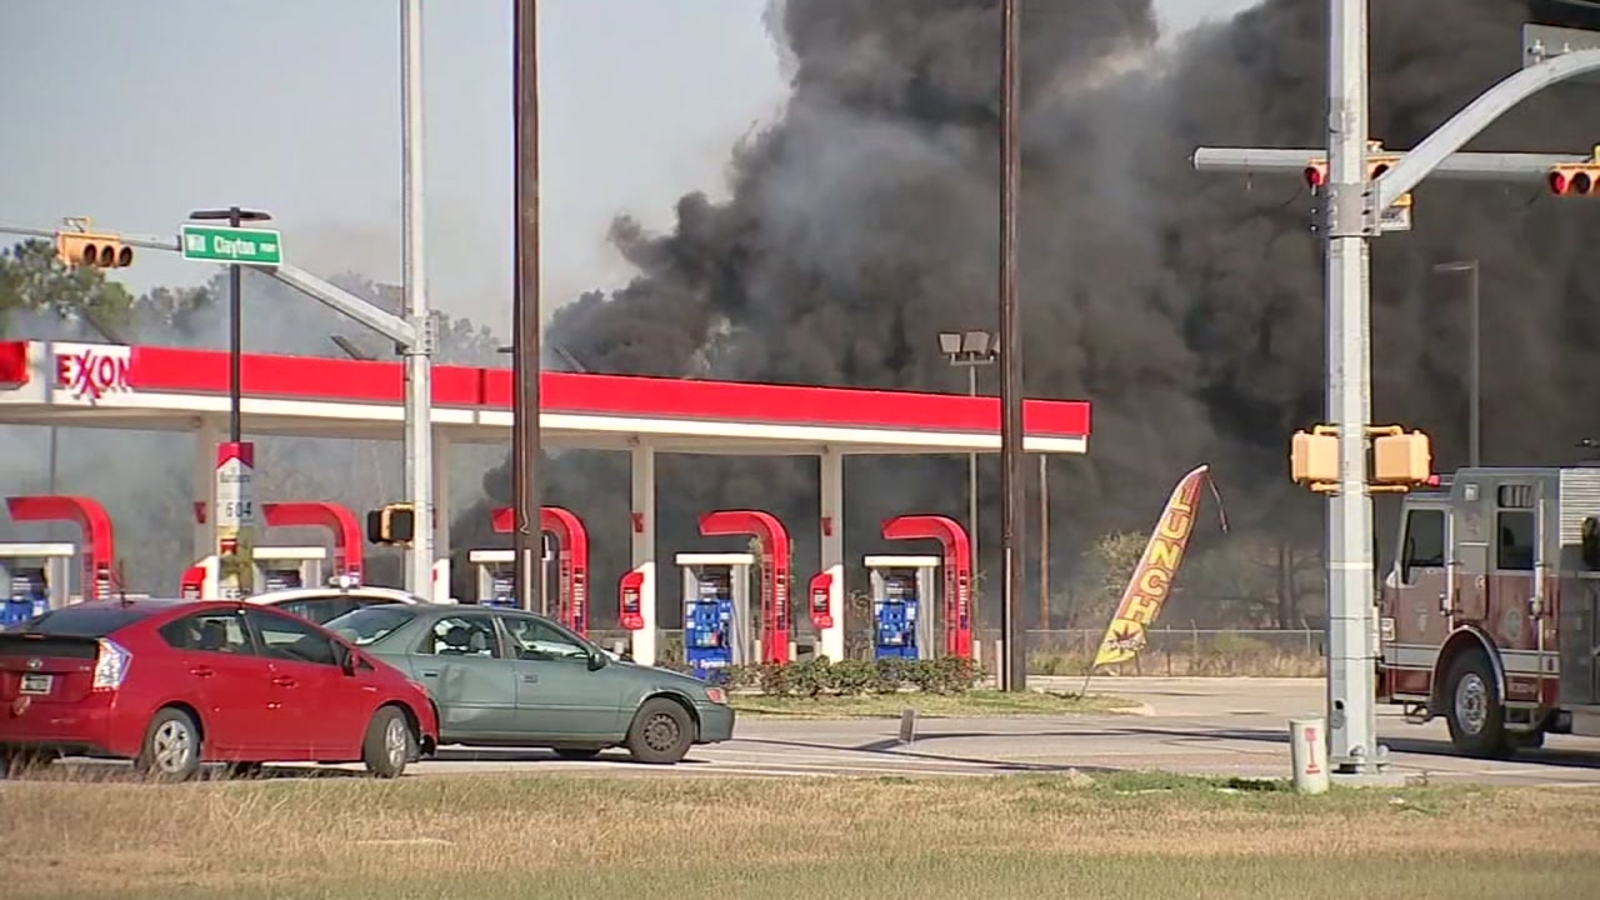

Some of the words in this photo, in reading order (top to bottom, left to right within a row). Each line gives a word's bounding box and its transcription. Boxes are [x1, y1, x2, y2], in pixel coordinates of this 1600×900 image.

[214, 235, 256, 258] Clayton
[56, 349, 132, 399] EXXON
[1124, 487, 1190, 626] LUNCH
